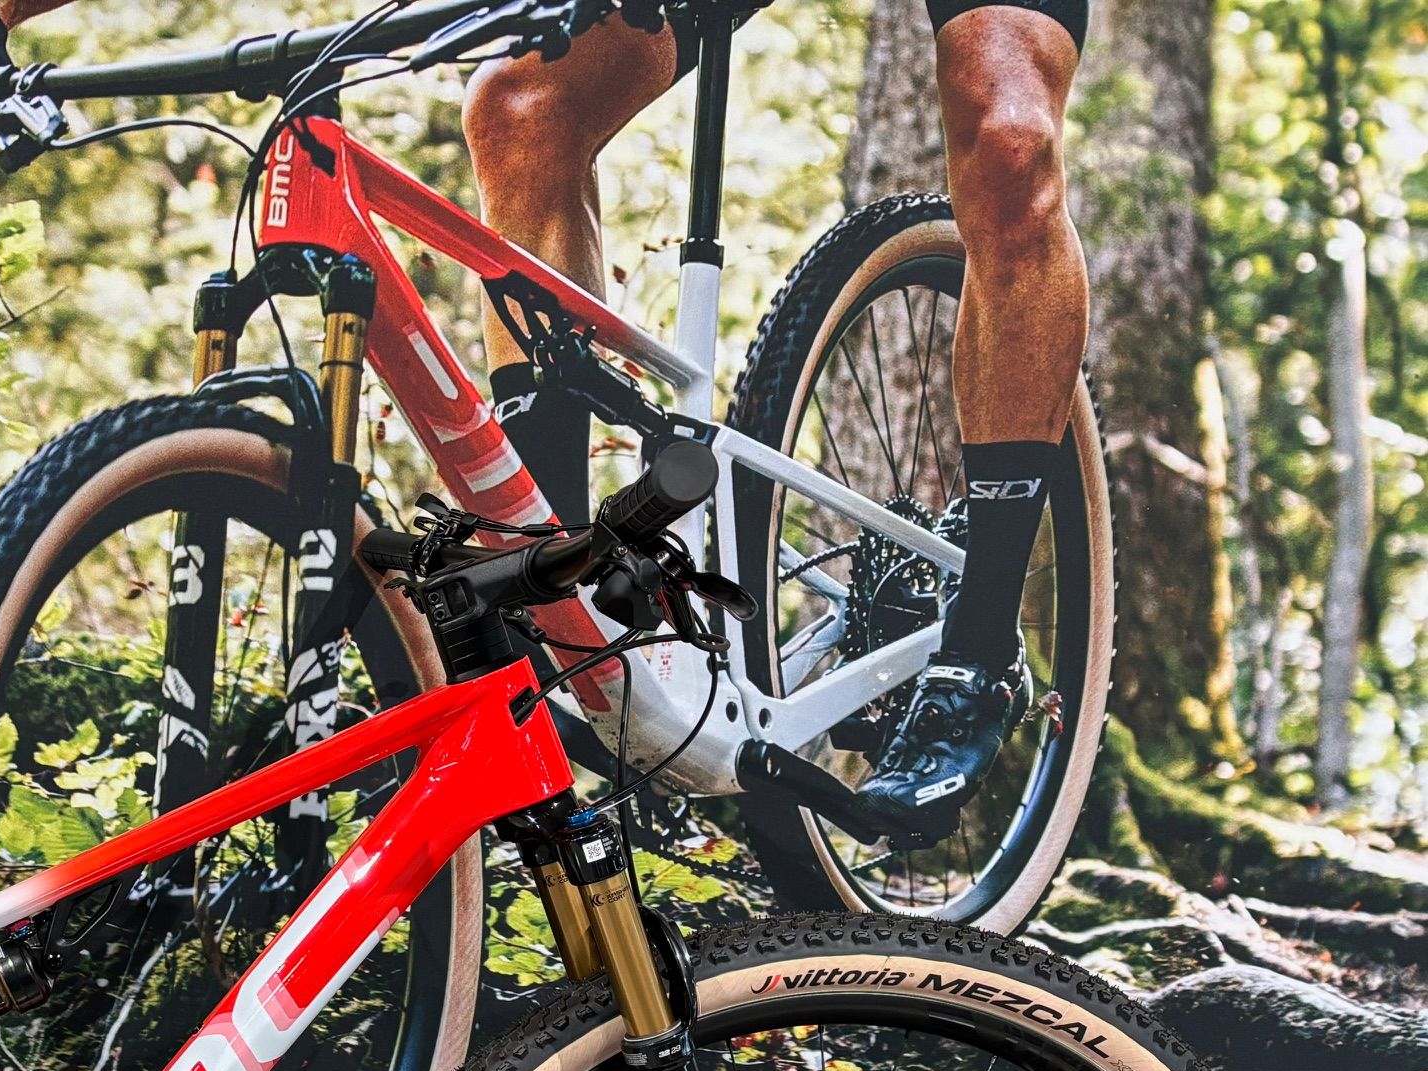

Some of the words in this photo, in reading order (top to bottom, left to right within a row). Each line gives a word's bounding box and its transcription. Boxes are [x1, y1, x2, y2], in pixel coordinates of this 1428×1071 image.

[266, 132, 294, 228] BMC
[969, 478, 1042, 500] SIDI
[924, 665, 977, 683] SIDI
[914, 772, 966, 807] SIDI
[782, 967, 908, 989] vittoria
[917, 973, 1110, 1059] MEZCAL
